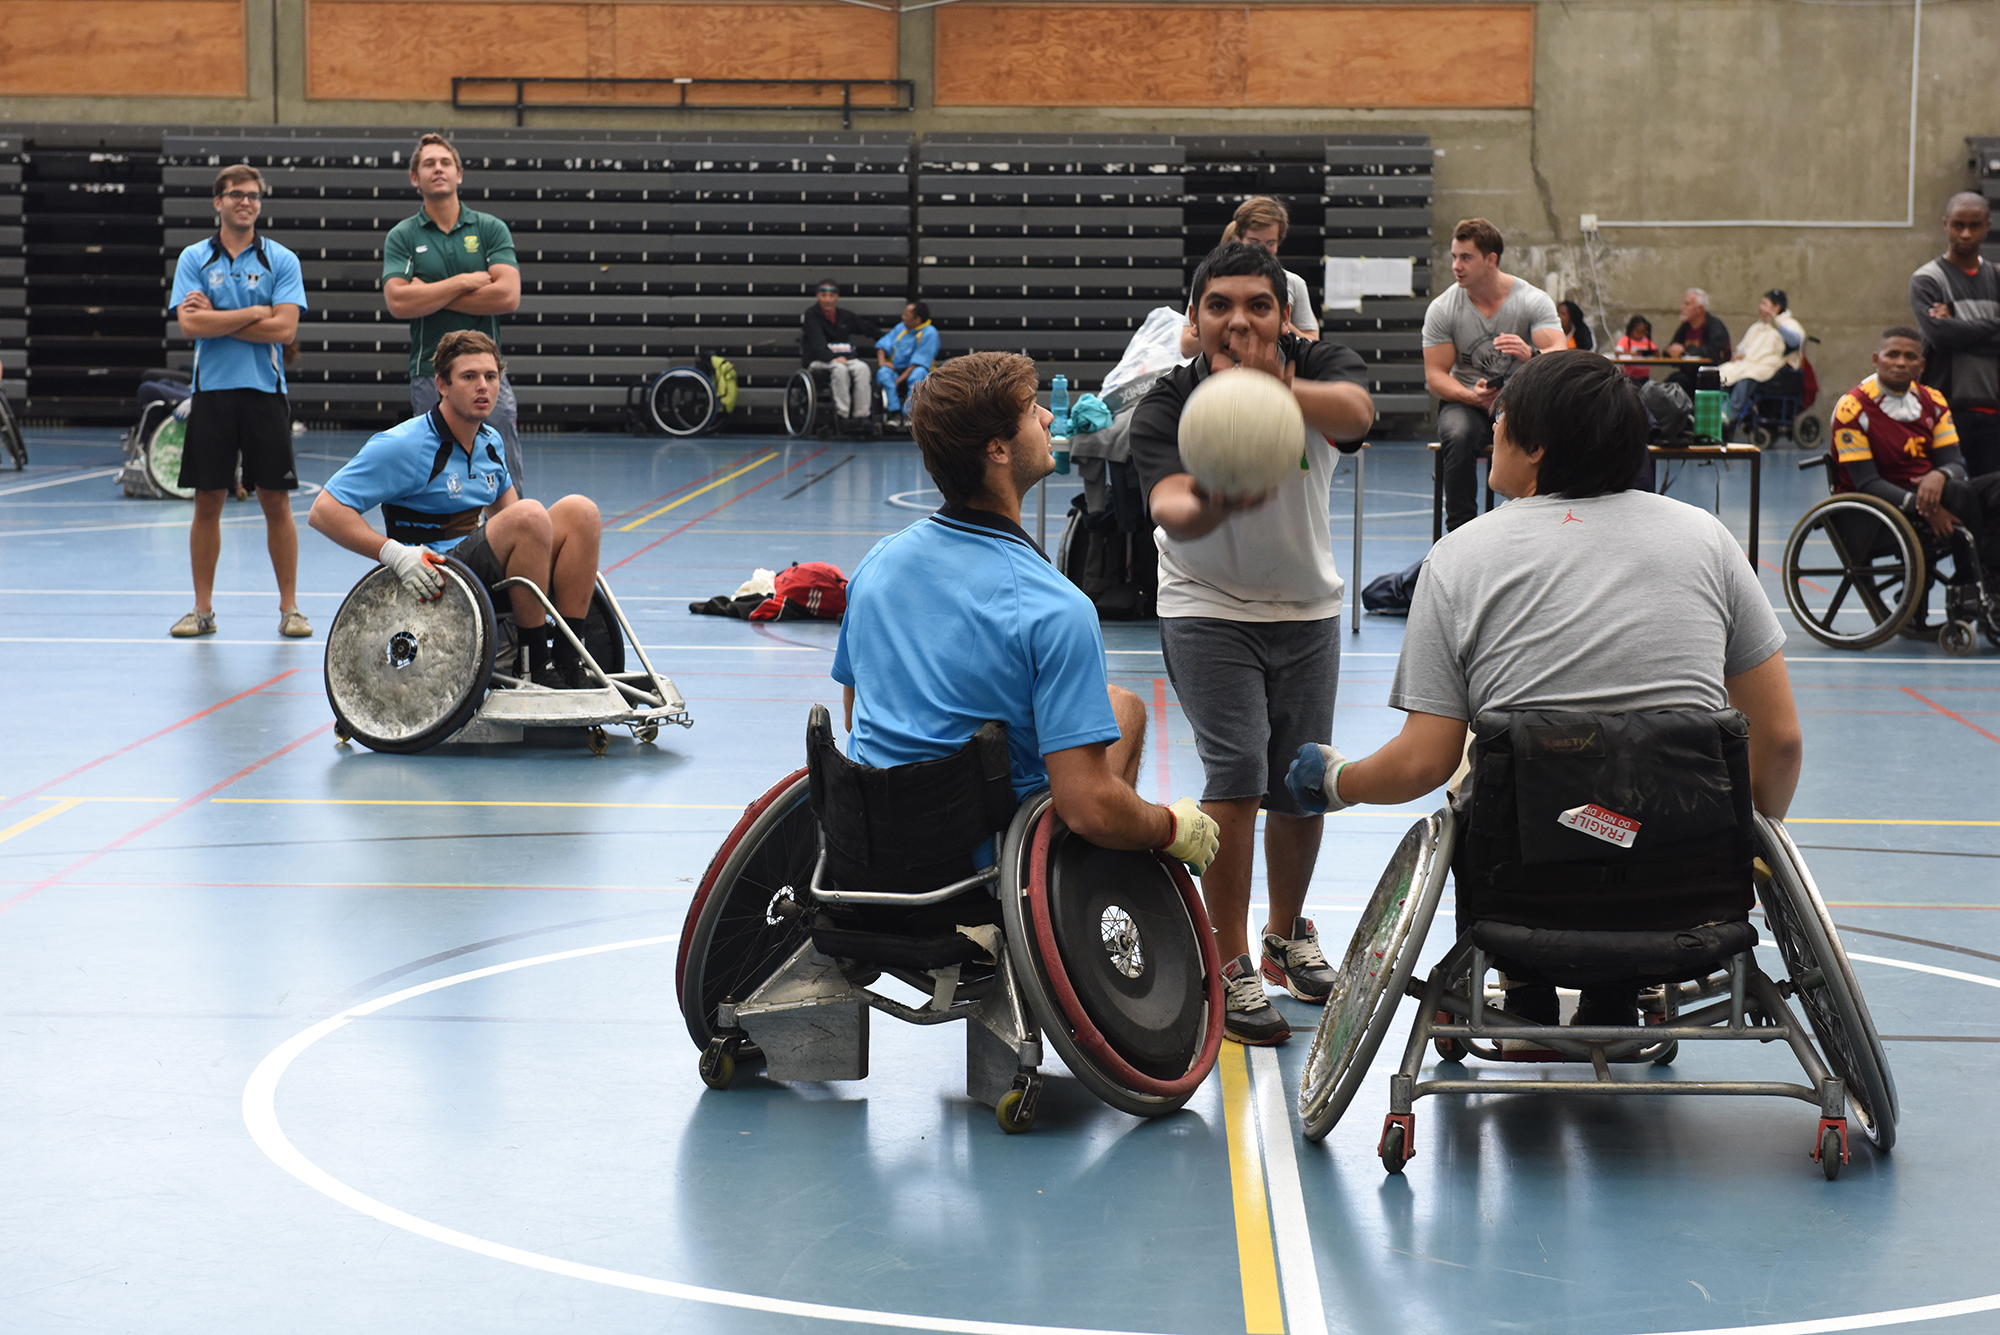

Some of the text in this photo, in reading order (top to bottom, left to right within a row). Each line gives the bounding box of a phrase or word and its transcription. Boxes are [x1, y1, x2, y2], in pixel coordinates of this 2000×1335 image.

[1597, 812, 1617, 824] NOT
[1618, 819, 1631, 829] DO
[1568, 815, 1626, 842] FRAGILE
